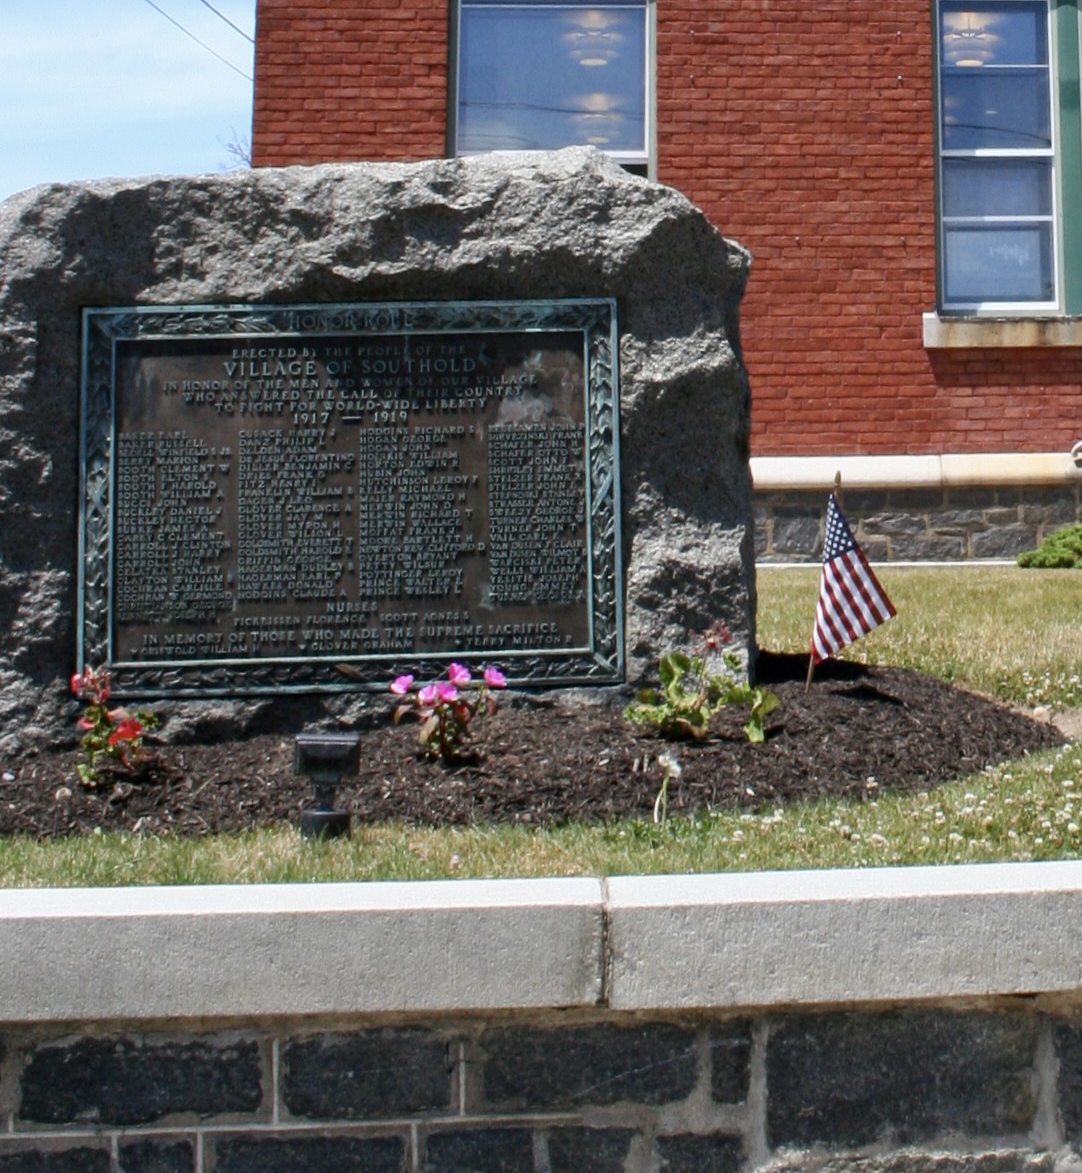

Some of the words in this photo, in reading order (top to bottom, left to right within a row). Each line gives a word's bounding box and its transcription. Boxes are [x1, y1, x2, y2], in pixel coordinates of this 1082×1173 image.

[288, 314, 356, 332] HONOR
[232, 348, 297, 358] ERECTED
[303, 347, 317, 357] BY
[325, 347, 350, 356] THE
[358, 346, 408, 356] PEOPLE
[416, 346, 432, 355] OF
[439, 345, 465, 354] THE
[224, 361, 318, 376] VILLAGE
[326, 361, 352, 374] OF
[362, 357, 476, 374] SOUTHOLD
[163, 381, 177, 391] IN
[182, 380, 228, 391] HONOR
[234, 380, 250, 389] OF
[256, 380, 284, 389] THE
[289, 379, 318, 388] MEN
[325, 378, 355, 388] AND
[360, 377, 413, 388] WOMEN
[418, 376, 433, 386] OF
[441, 376, 469, 385] OUR
[476, 374, 537, 385] VILLAGE
[182, 392, 215, 401] WHO
[220, 390, 300, 401] ANSWERED
[306, 390, 334, 400] THE
[341, 389, 378, 399] CALL
[384, 389, 400, 398] OF
[408, 387, 449, 398] THEIR
[455, 385, 523, 397] COUNTRY
[215, 403, 234, 412] TO
[240, 402, 283, 412] FIGHT
[290, 401, 317, 411] FOR
[322, 399, 419, 411] WORLD-WIDE
[425, 397, 487, 409] LIBERTY
[293, 412, 330, 424] 1917
[374, 410, 408, 423] 1919
[326, 601, 378, 612] NURSES
[306, 613, 367, 624] FLORENCE
[379, 612, 418, 622] SCOTT
[423, 611, 459, 621] AGNES
[143, 634, 157, 644] IN
[164, 632, 223, 644] MEMORY
[228, 632, 246, 643] OF
[251, 630, 295, 642] THOSE
[303, 629, 333, 640] WHO
[340, 628, 379, 639] MADE
[384, 626, 414, 637] THE
[419, 625, 483, 636] SUPREME
[489, 622, 558, 635] SACRIFICE
[512, 634, 560, 645] MILTON
[201, 644, 248, 654] WILLIAM
